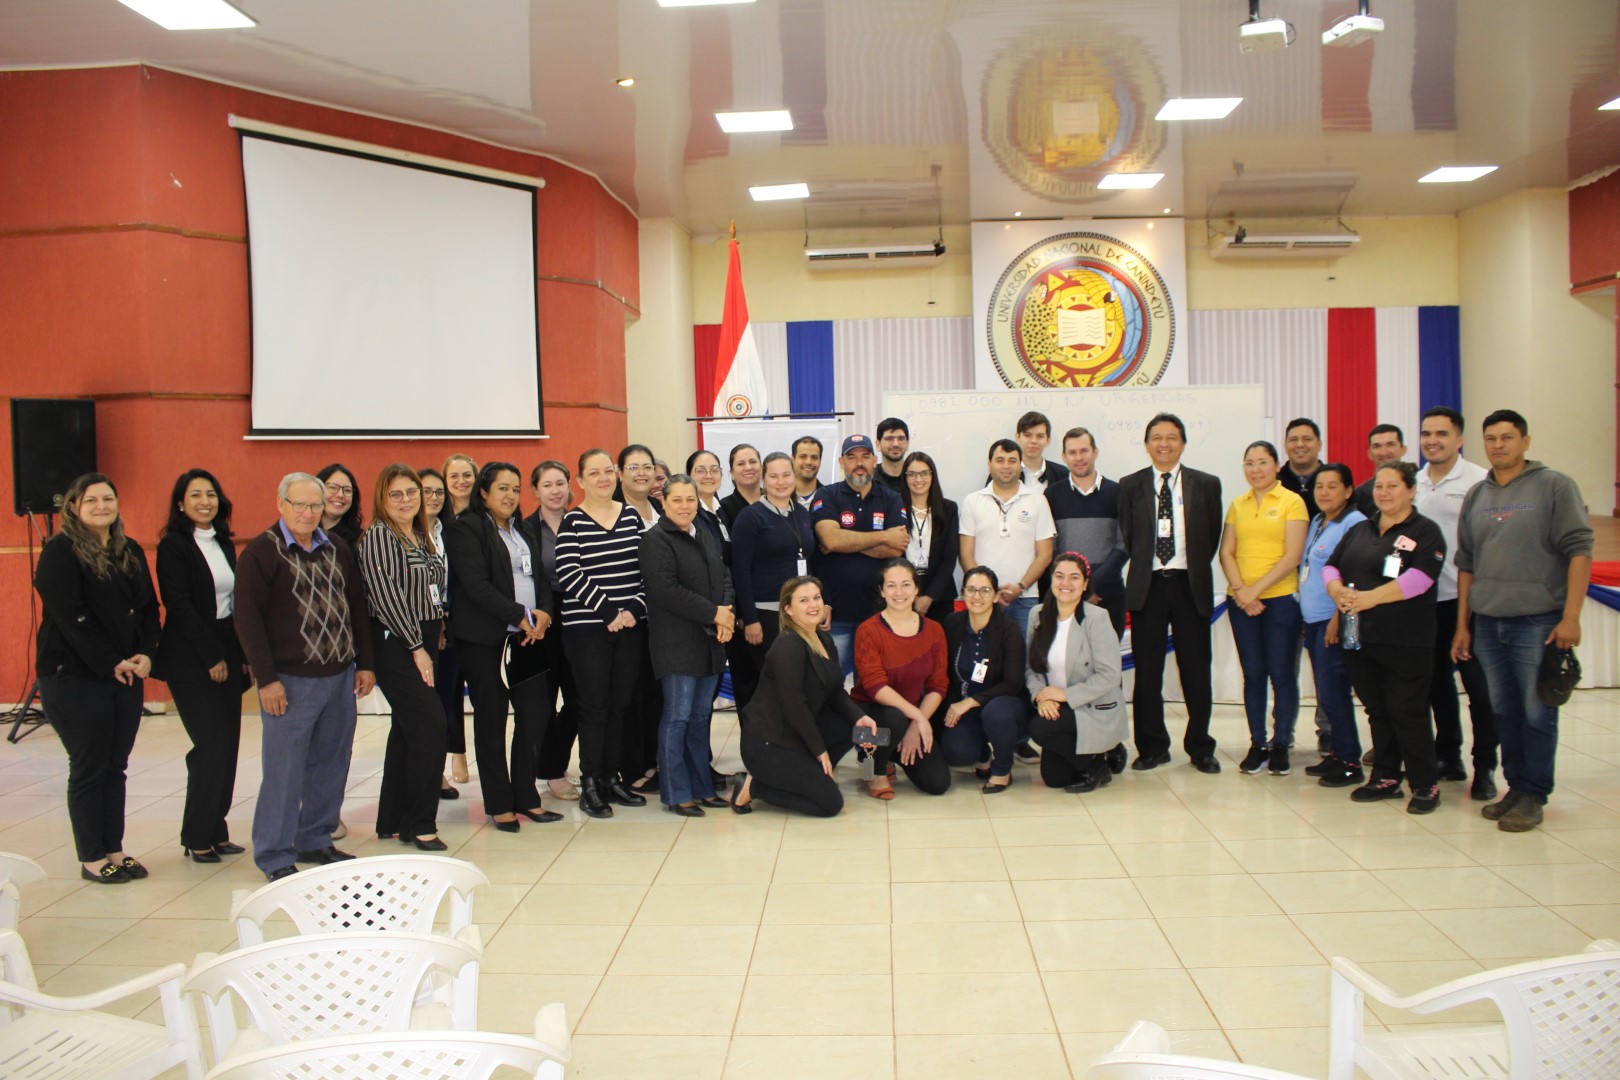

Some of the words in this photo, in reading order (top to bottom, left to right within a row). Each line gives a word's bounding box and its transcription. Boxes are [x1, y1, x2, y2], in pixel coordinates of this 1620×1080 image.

[997, 257, 1041, 323] UNIVERSIDAD
[1044, 242, 1102, 260] NACIONAL
[1106, 247, 1124, 263] DE
